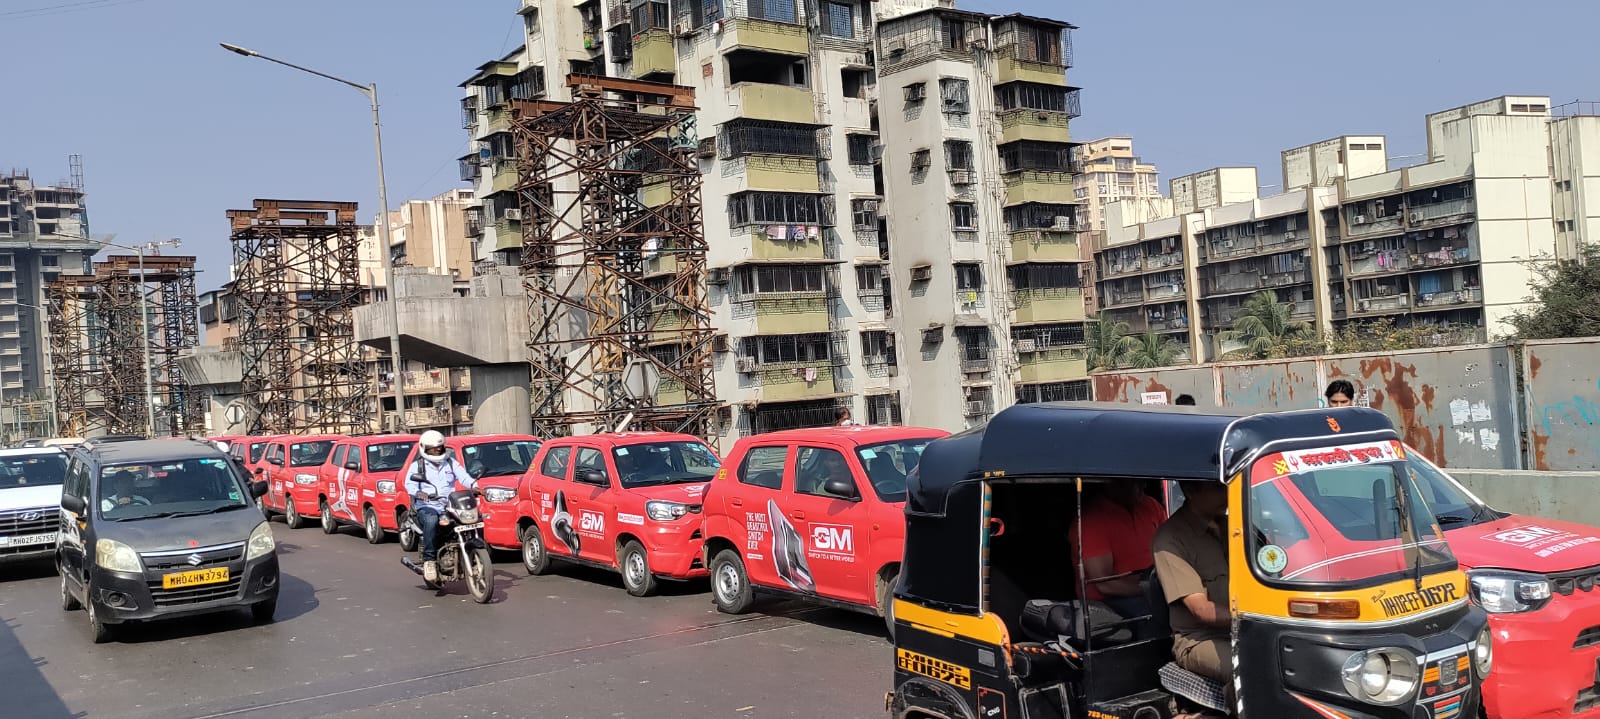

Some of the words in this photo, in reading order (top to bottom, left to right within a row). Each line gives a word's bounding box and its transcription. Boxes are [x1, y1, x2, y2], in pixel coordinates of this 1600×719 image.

[580, 512, 604, 532] GM
[811, 526, 852, 551] GM
[1495, 526, 1561, 543] GM
[170, 570, 228, 585] MH04HN3794
[987, 706, 1000, 717] CNG
